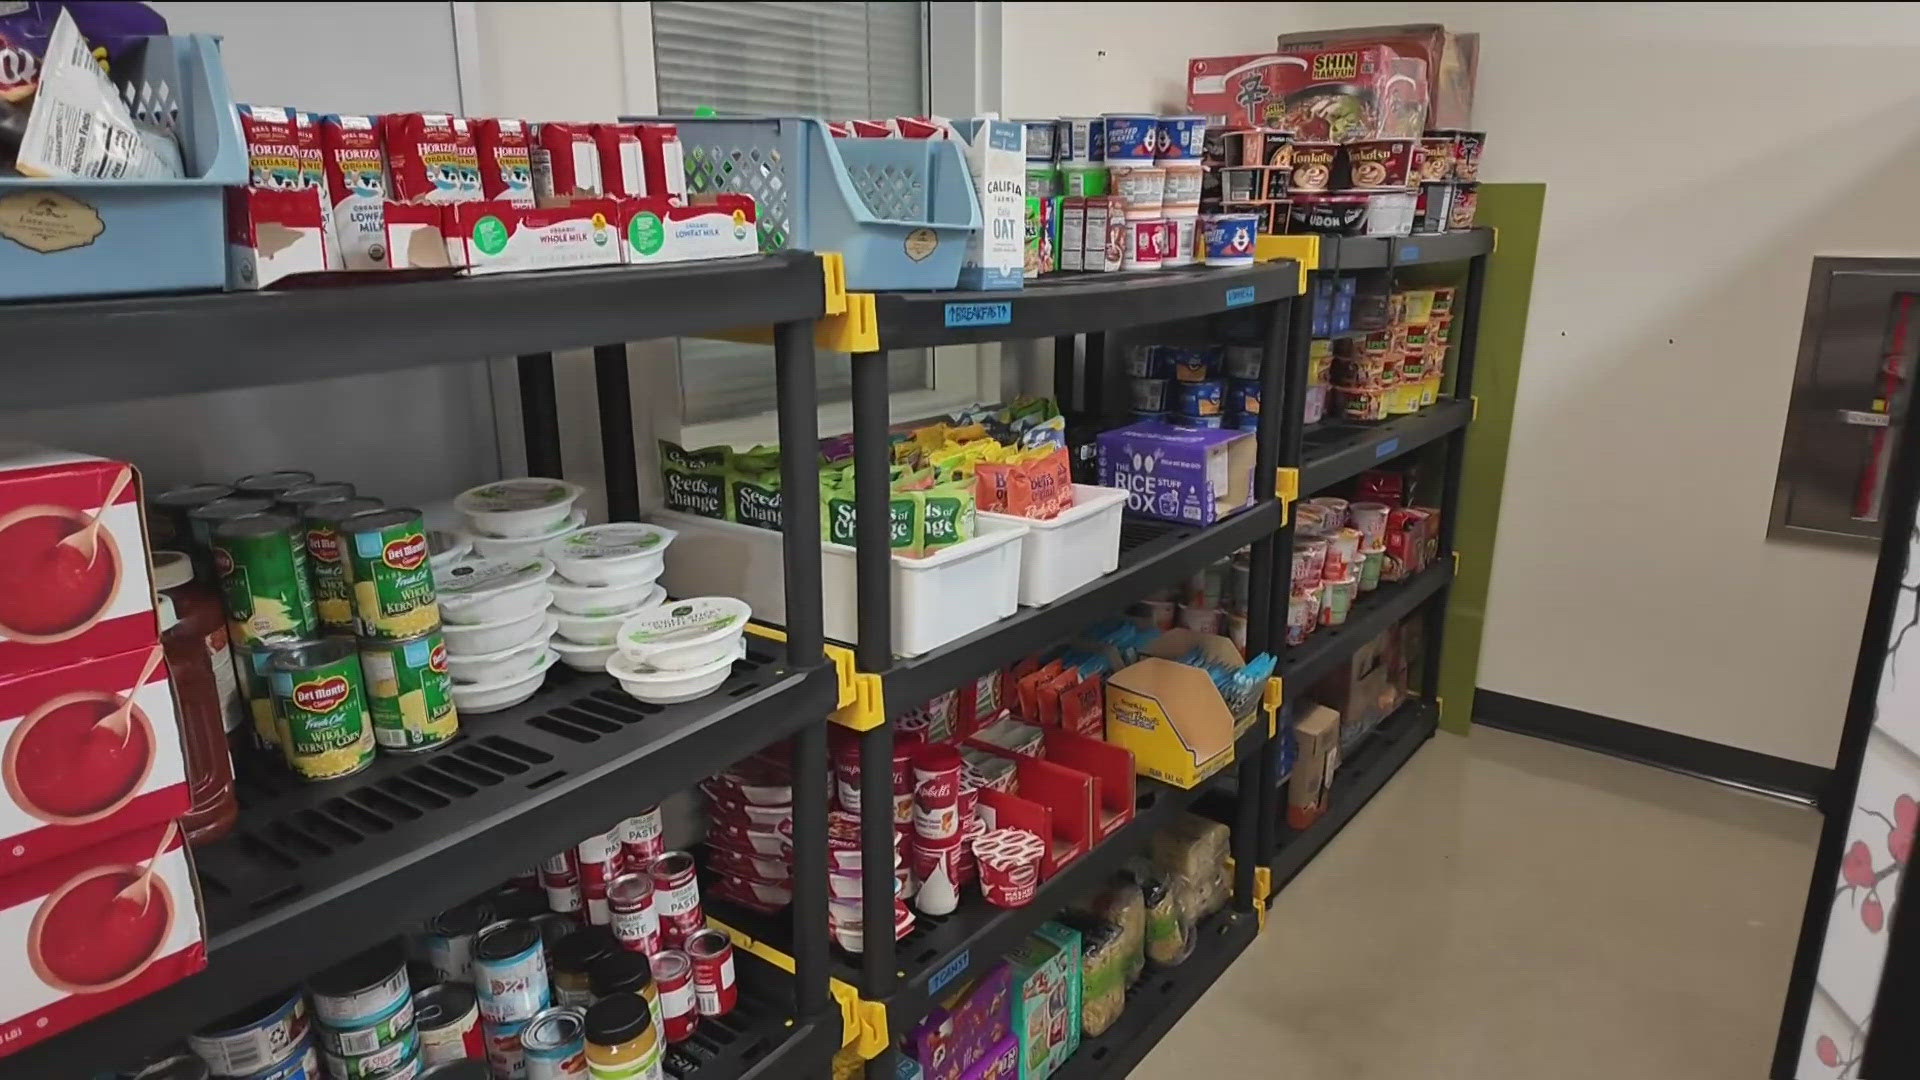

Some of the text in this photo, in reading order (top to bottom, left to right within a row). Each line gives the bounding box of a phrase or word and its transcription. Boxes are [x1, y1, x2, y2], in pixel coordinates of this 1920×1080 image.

[1313, 53, 1356, 71] SHIN
[334, 149, 381, 161] HORIZO
[493, 147, 528, 157] HORIZO
[987, 180, 1022, 196] CALIFIA
[993, 218, 1016, 240] OAT
[541, 233, 588, 243] WHOLE MILK
[1116, 462, 1130, 472] THE
[668, 473, 709, 494] Seeds
[1115, 471, 1157, 495] RICE
[1128, 493, 1158, 514] OX
[297, 684, 346, 703] Del Monte
[628, 826, 658, 839] PASTE
[670, 894, 698, 912] PASTE
[615, 925, 647, 938] PASTE
